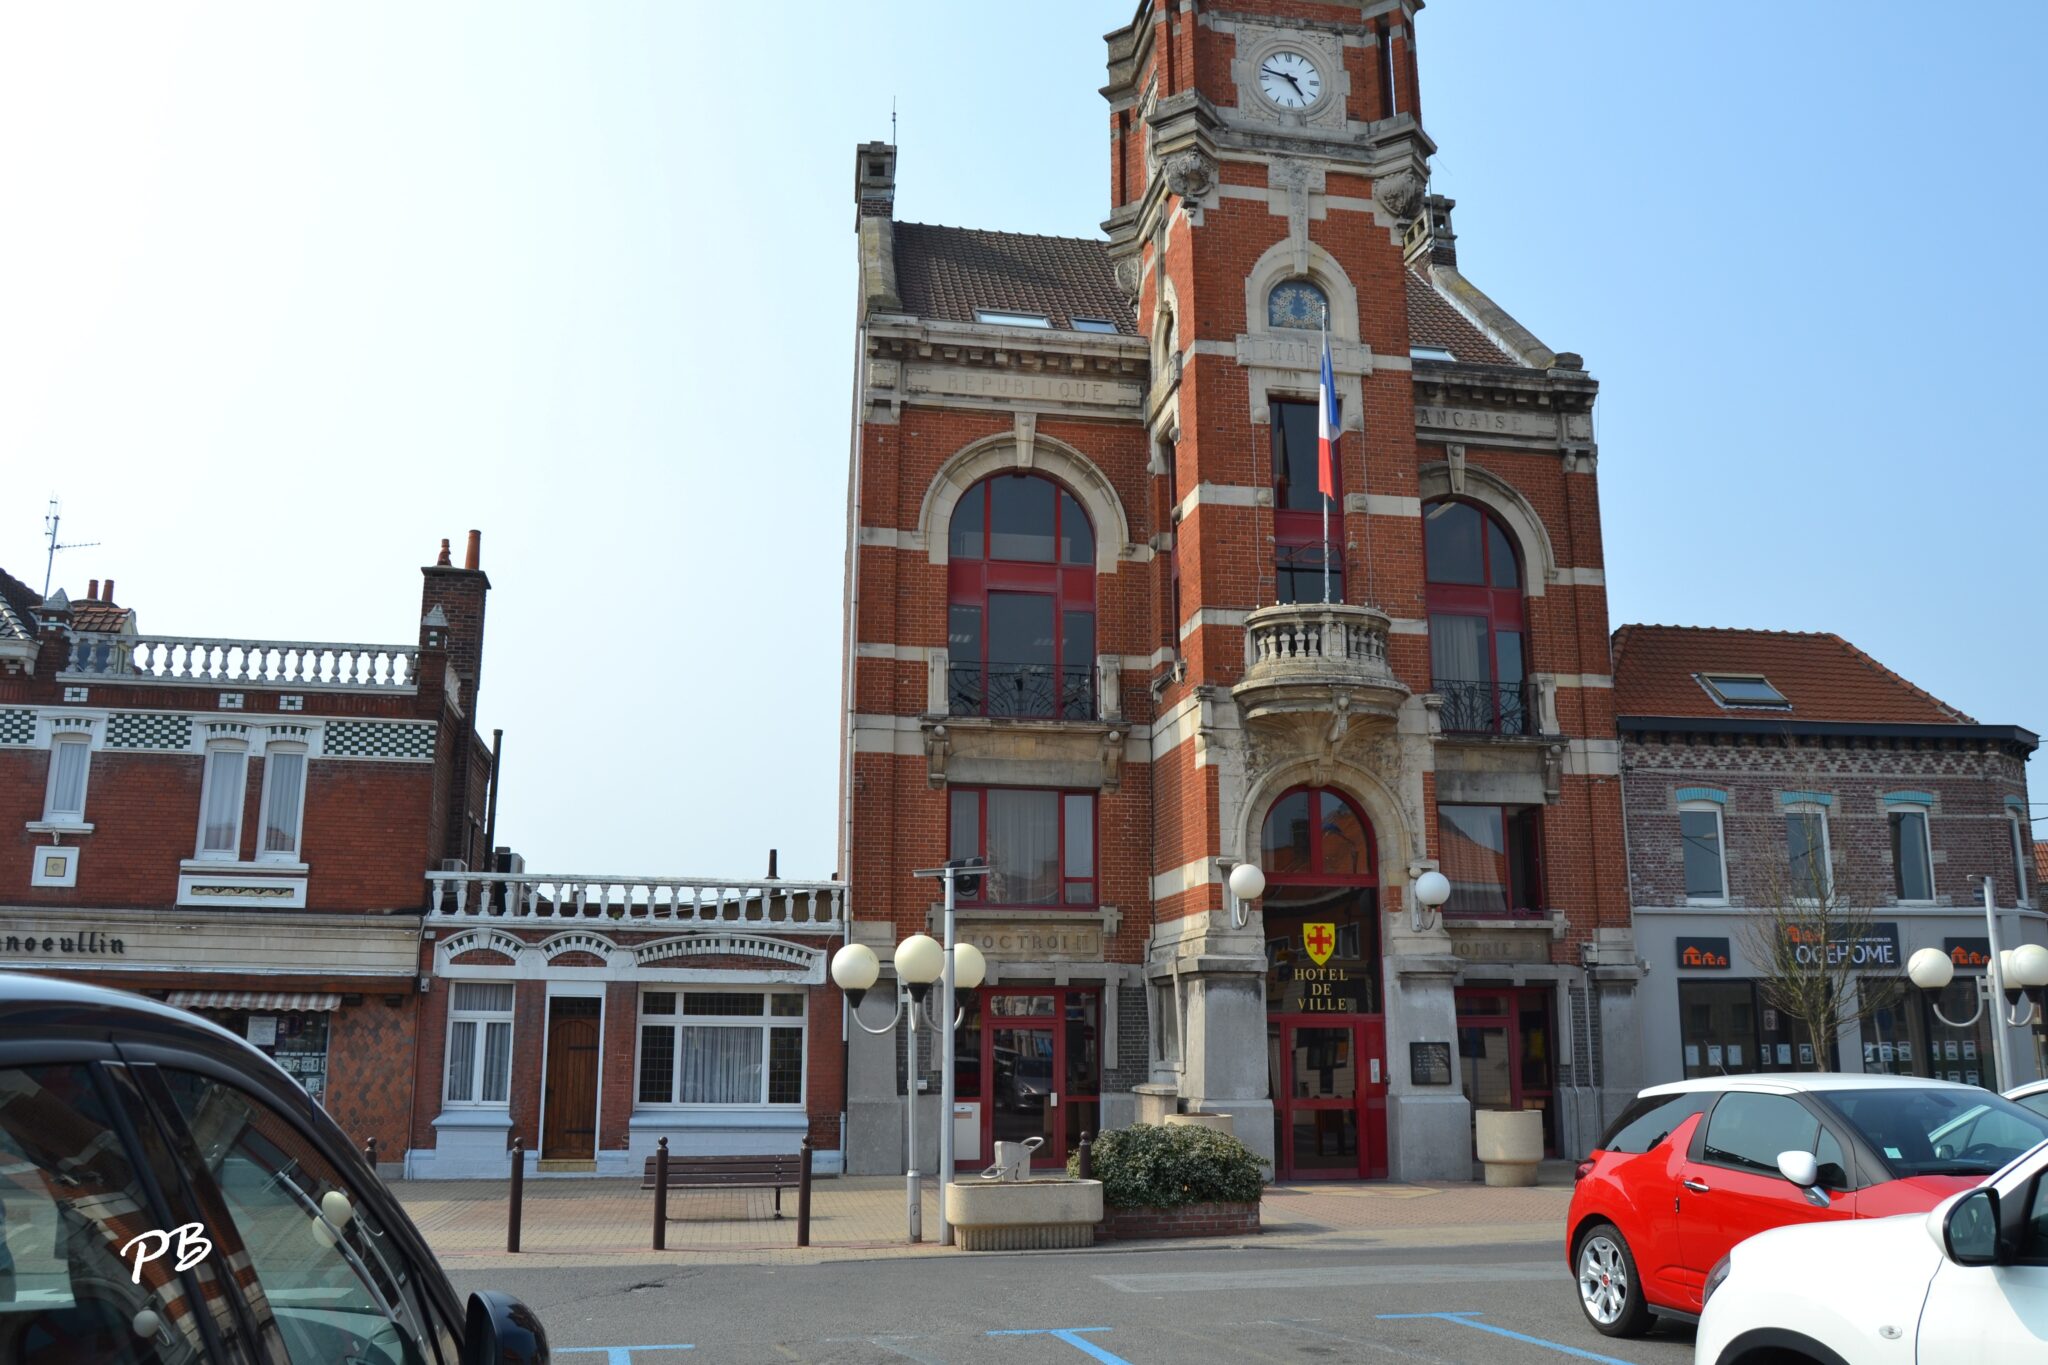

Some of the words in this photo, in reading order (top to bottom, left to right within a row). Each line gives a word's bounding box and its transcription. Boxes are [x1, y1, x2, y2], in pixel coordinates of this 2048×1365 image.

[1269, 342, 1343, 365] MAIRE
[948, 374, 1103, 401] REPUBLIQUE
[1420, 409, 1522, 432] ANCAISE
[0, 931, 124, 954] noeullin
[982, 935, 1068, 949] OCTROI
[1786, 945, 1894, 963] OGEHOME
[1294, 968, 1349, 981] HOTEL
[1312, 983, 1332, 996] DE
[1297, 998, 1347, 1010] VILLE
